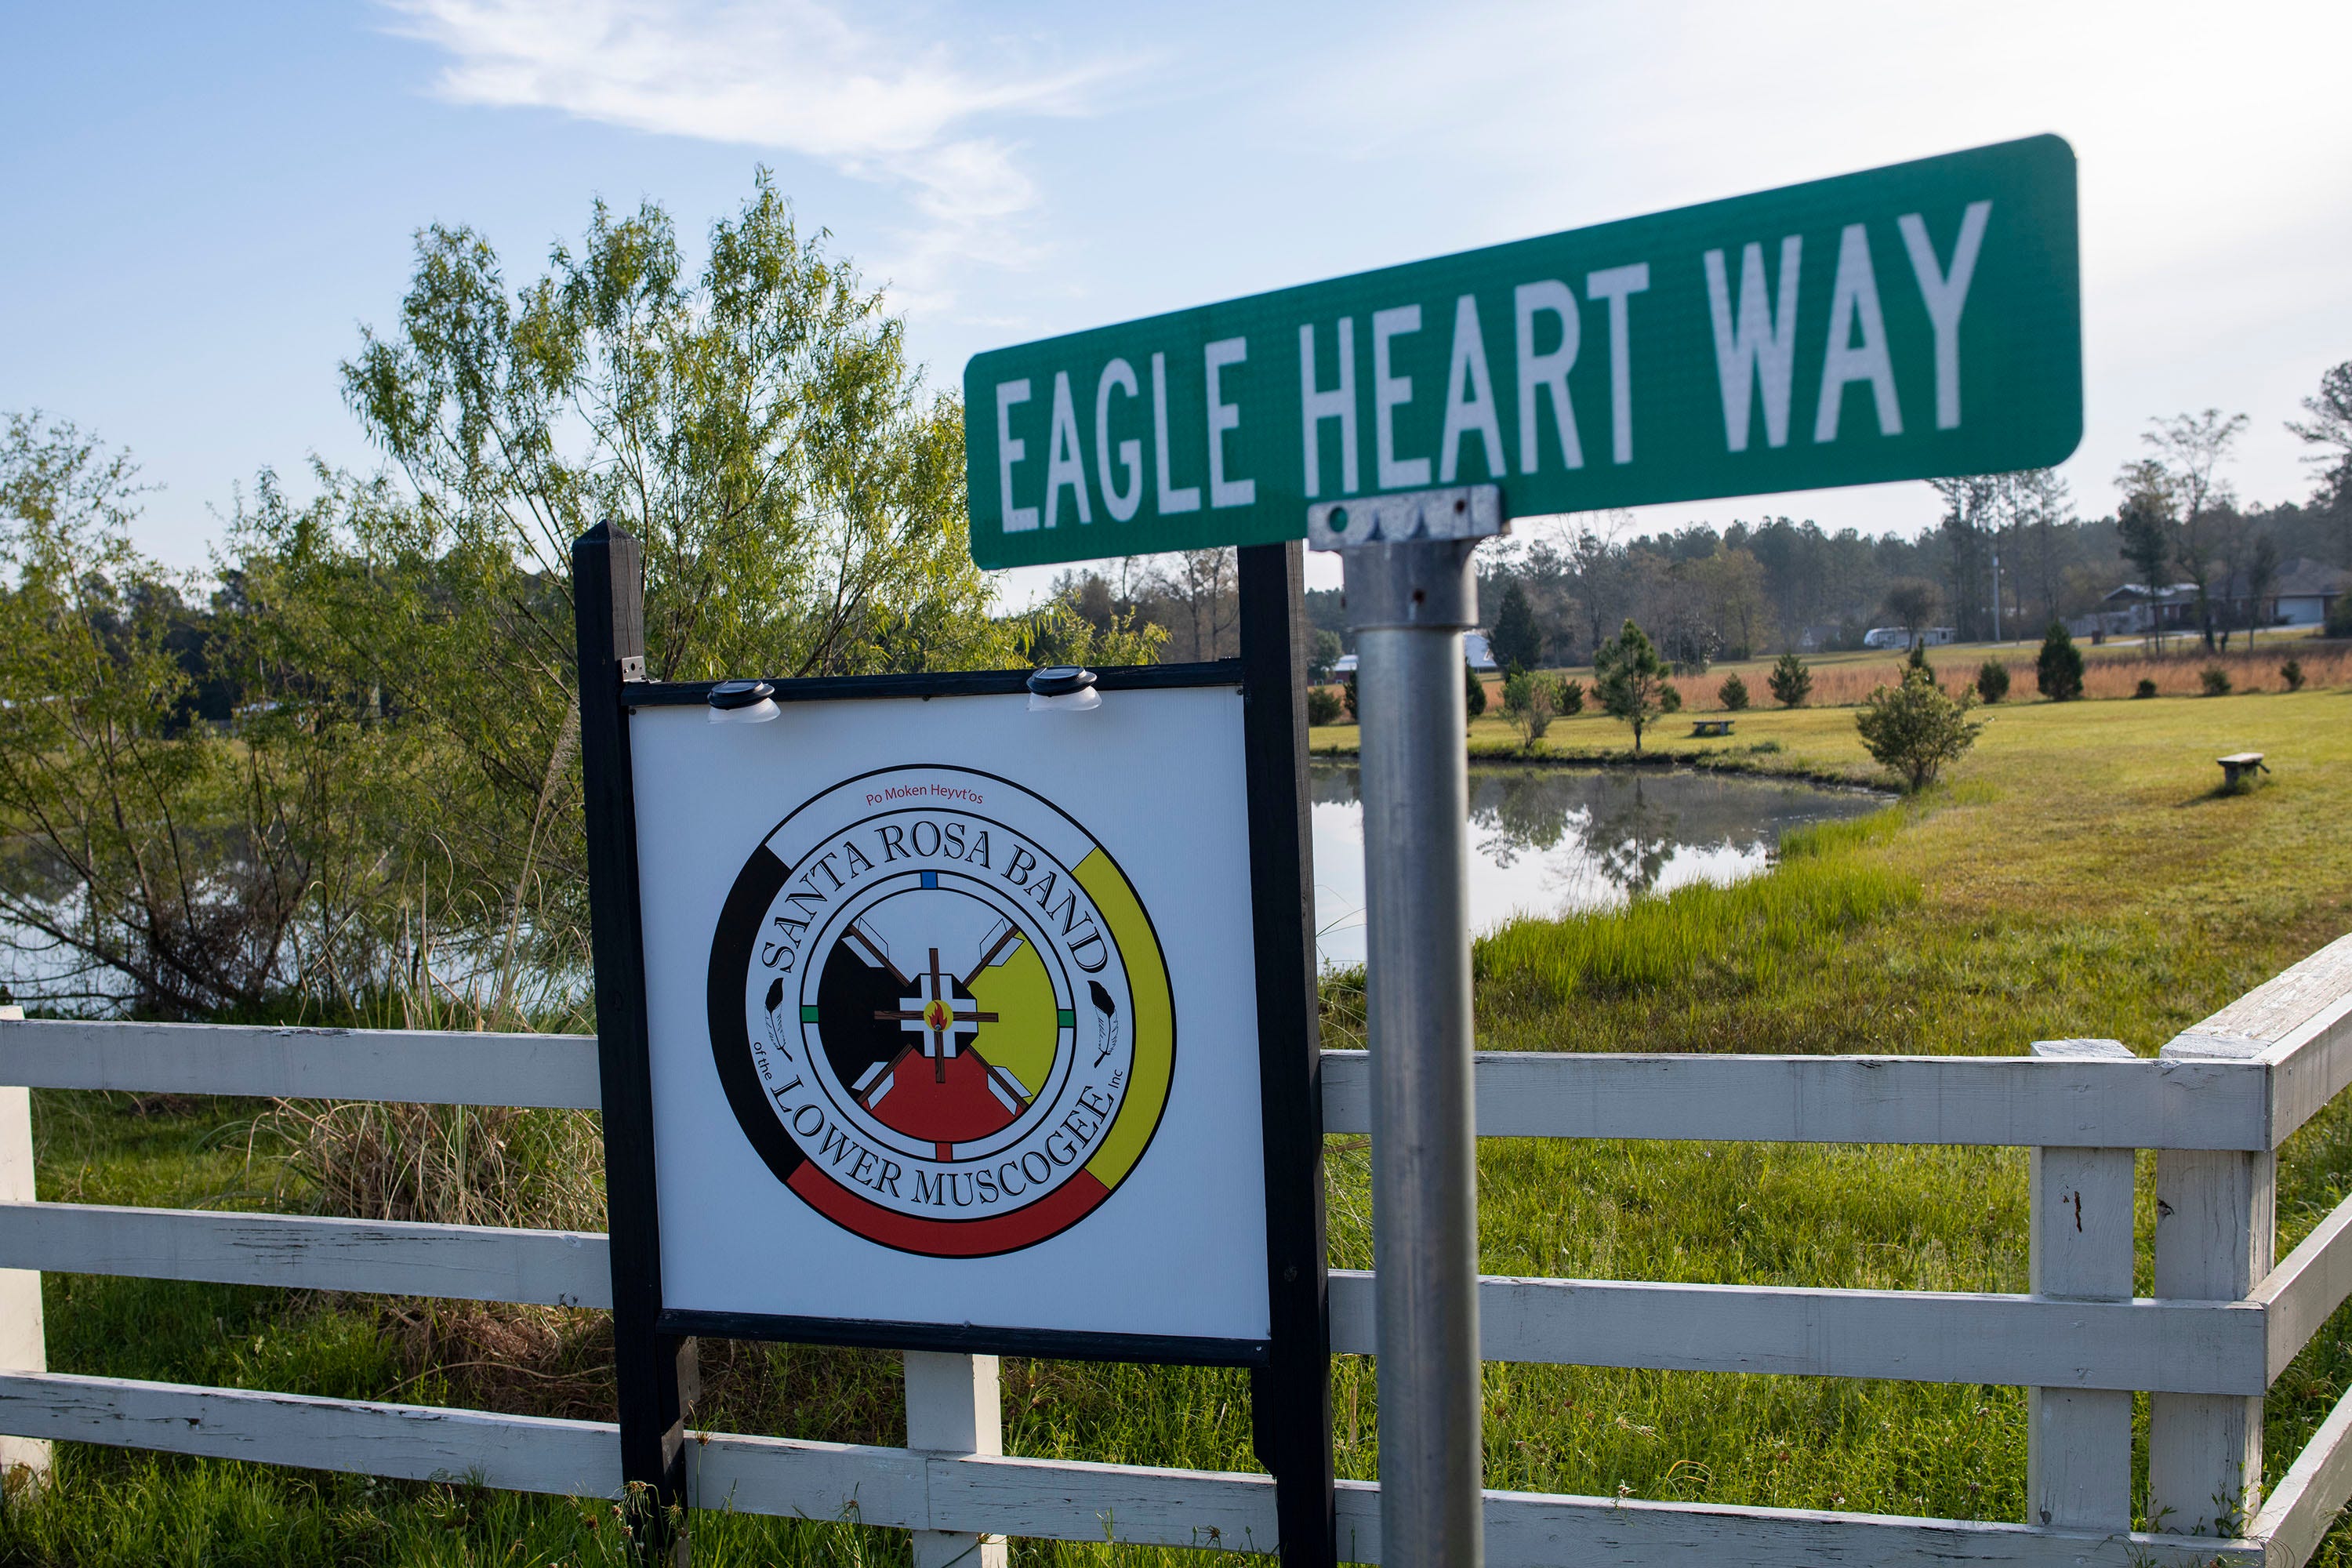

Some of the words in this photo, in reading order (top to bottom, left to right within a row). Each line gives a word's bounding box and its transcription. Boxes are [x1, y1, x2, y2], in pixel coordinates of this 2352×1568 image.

[996, 336, 1256, 534] EAGLE
[1298, 261, 1650, 499] HEART
[1703, 199, 1993, 452] WAY
[866, 794, 883, 806] Po
[884, 785, 927, 800] Moken
[761, 840, 876, 974] SANTA
[874, 820, 993, 869] ROSA
[1000, 844, 1109, 974] BAND
[753, 1042, 767, 1055] of
[757, 1058, 772, 1080] the
[770, 1074, 902, 1199] LOWER
[910, 1084, 1115, 1207] MUSCOGEE
[1108, 1069, 1123, 1089] Inc
